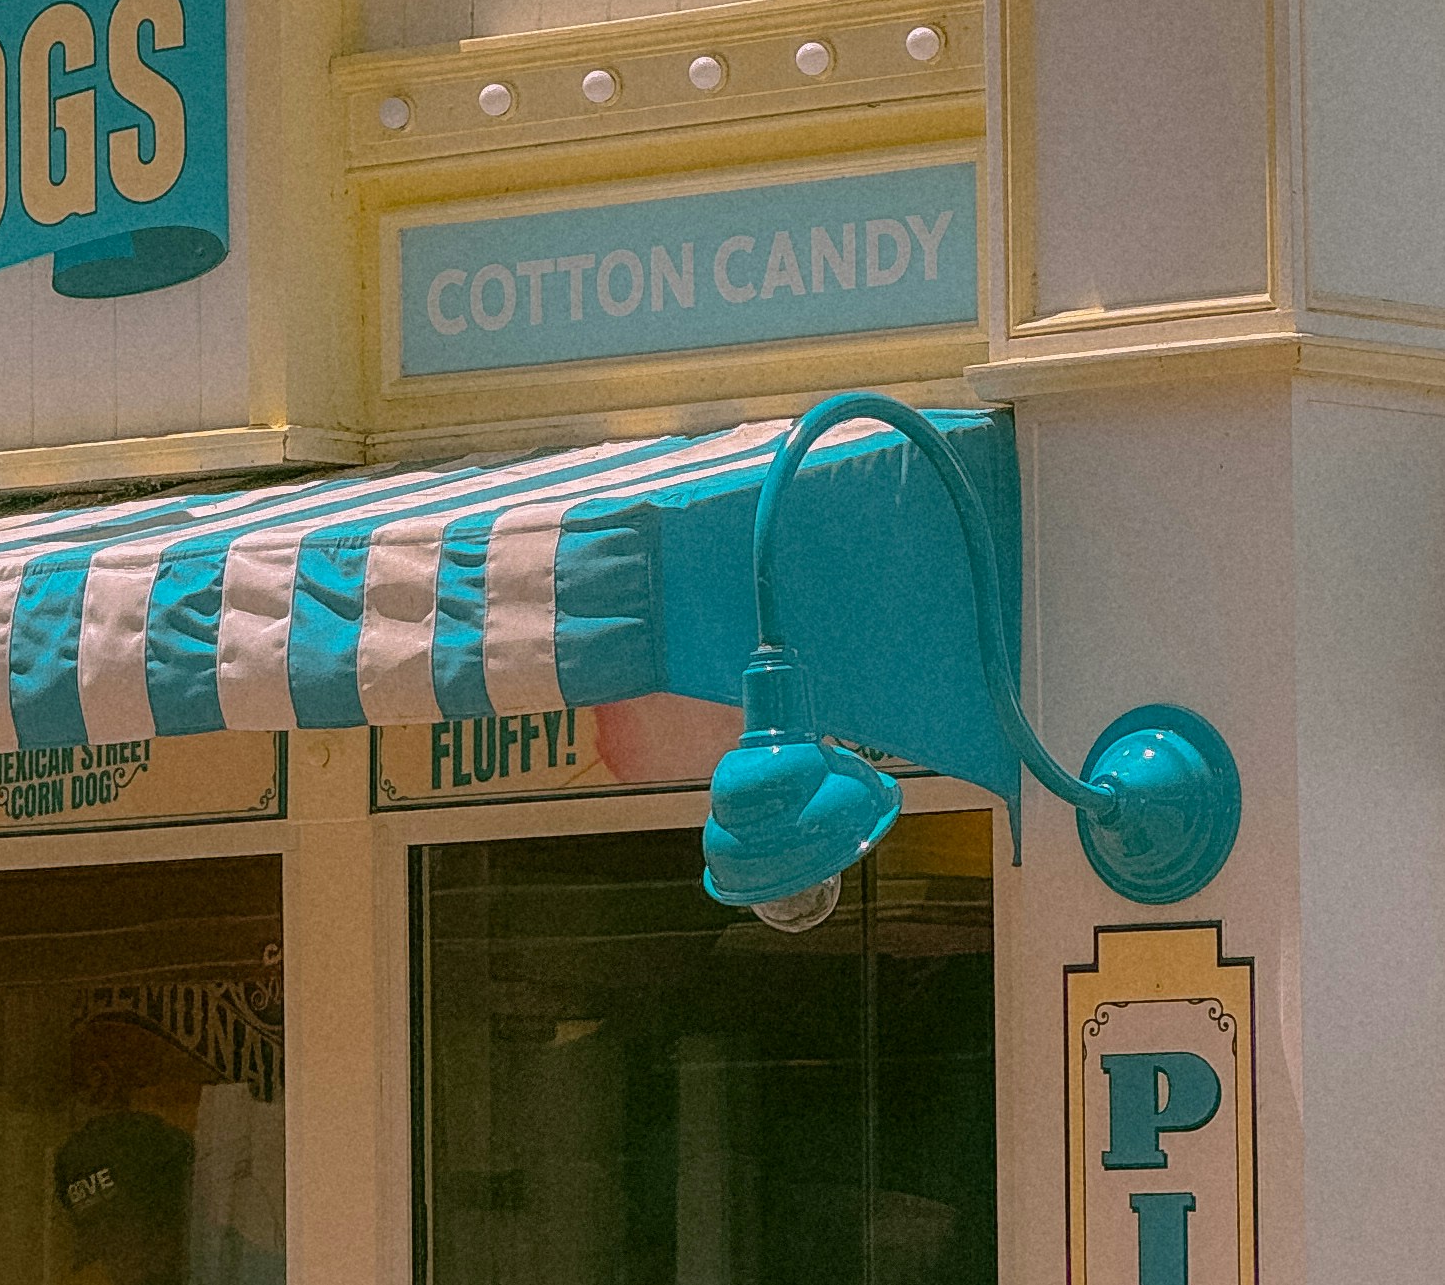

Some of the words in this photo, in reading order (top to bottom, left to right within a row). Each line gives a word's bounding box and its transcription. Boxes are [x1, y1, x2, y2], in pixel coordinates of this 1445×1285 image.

[427, 242, 694, 335] COTTON
[713, 210, 954, 304] CANDY
[81, 740, 150, 770] STREET
[431, 708, 576, 789] FLUFFY!
[11, 779, 64, 819] CORN
[72, 770, 112, 809] DOG
